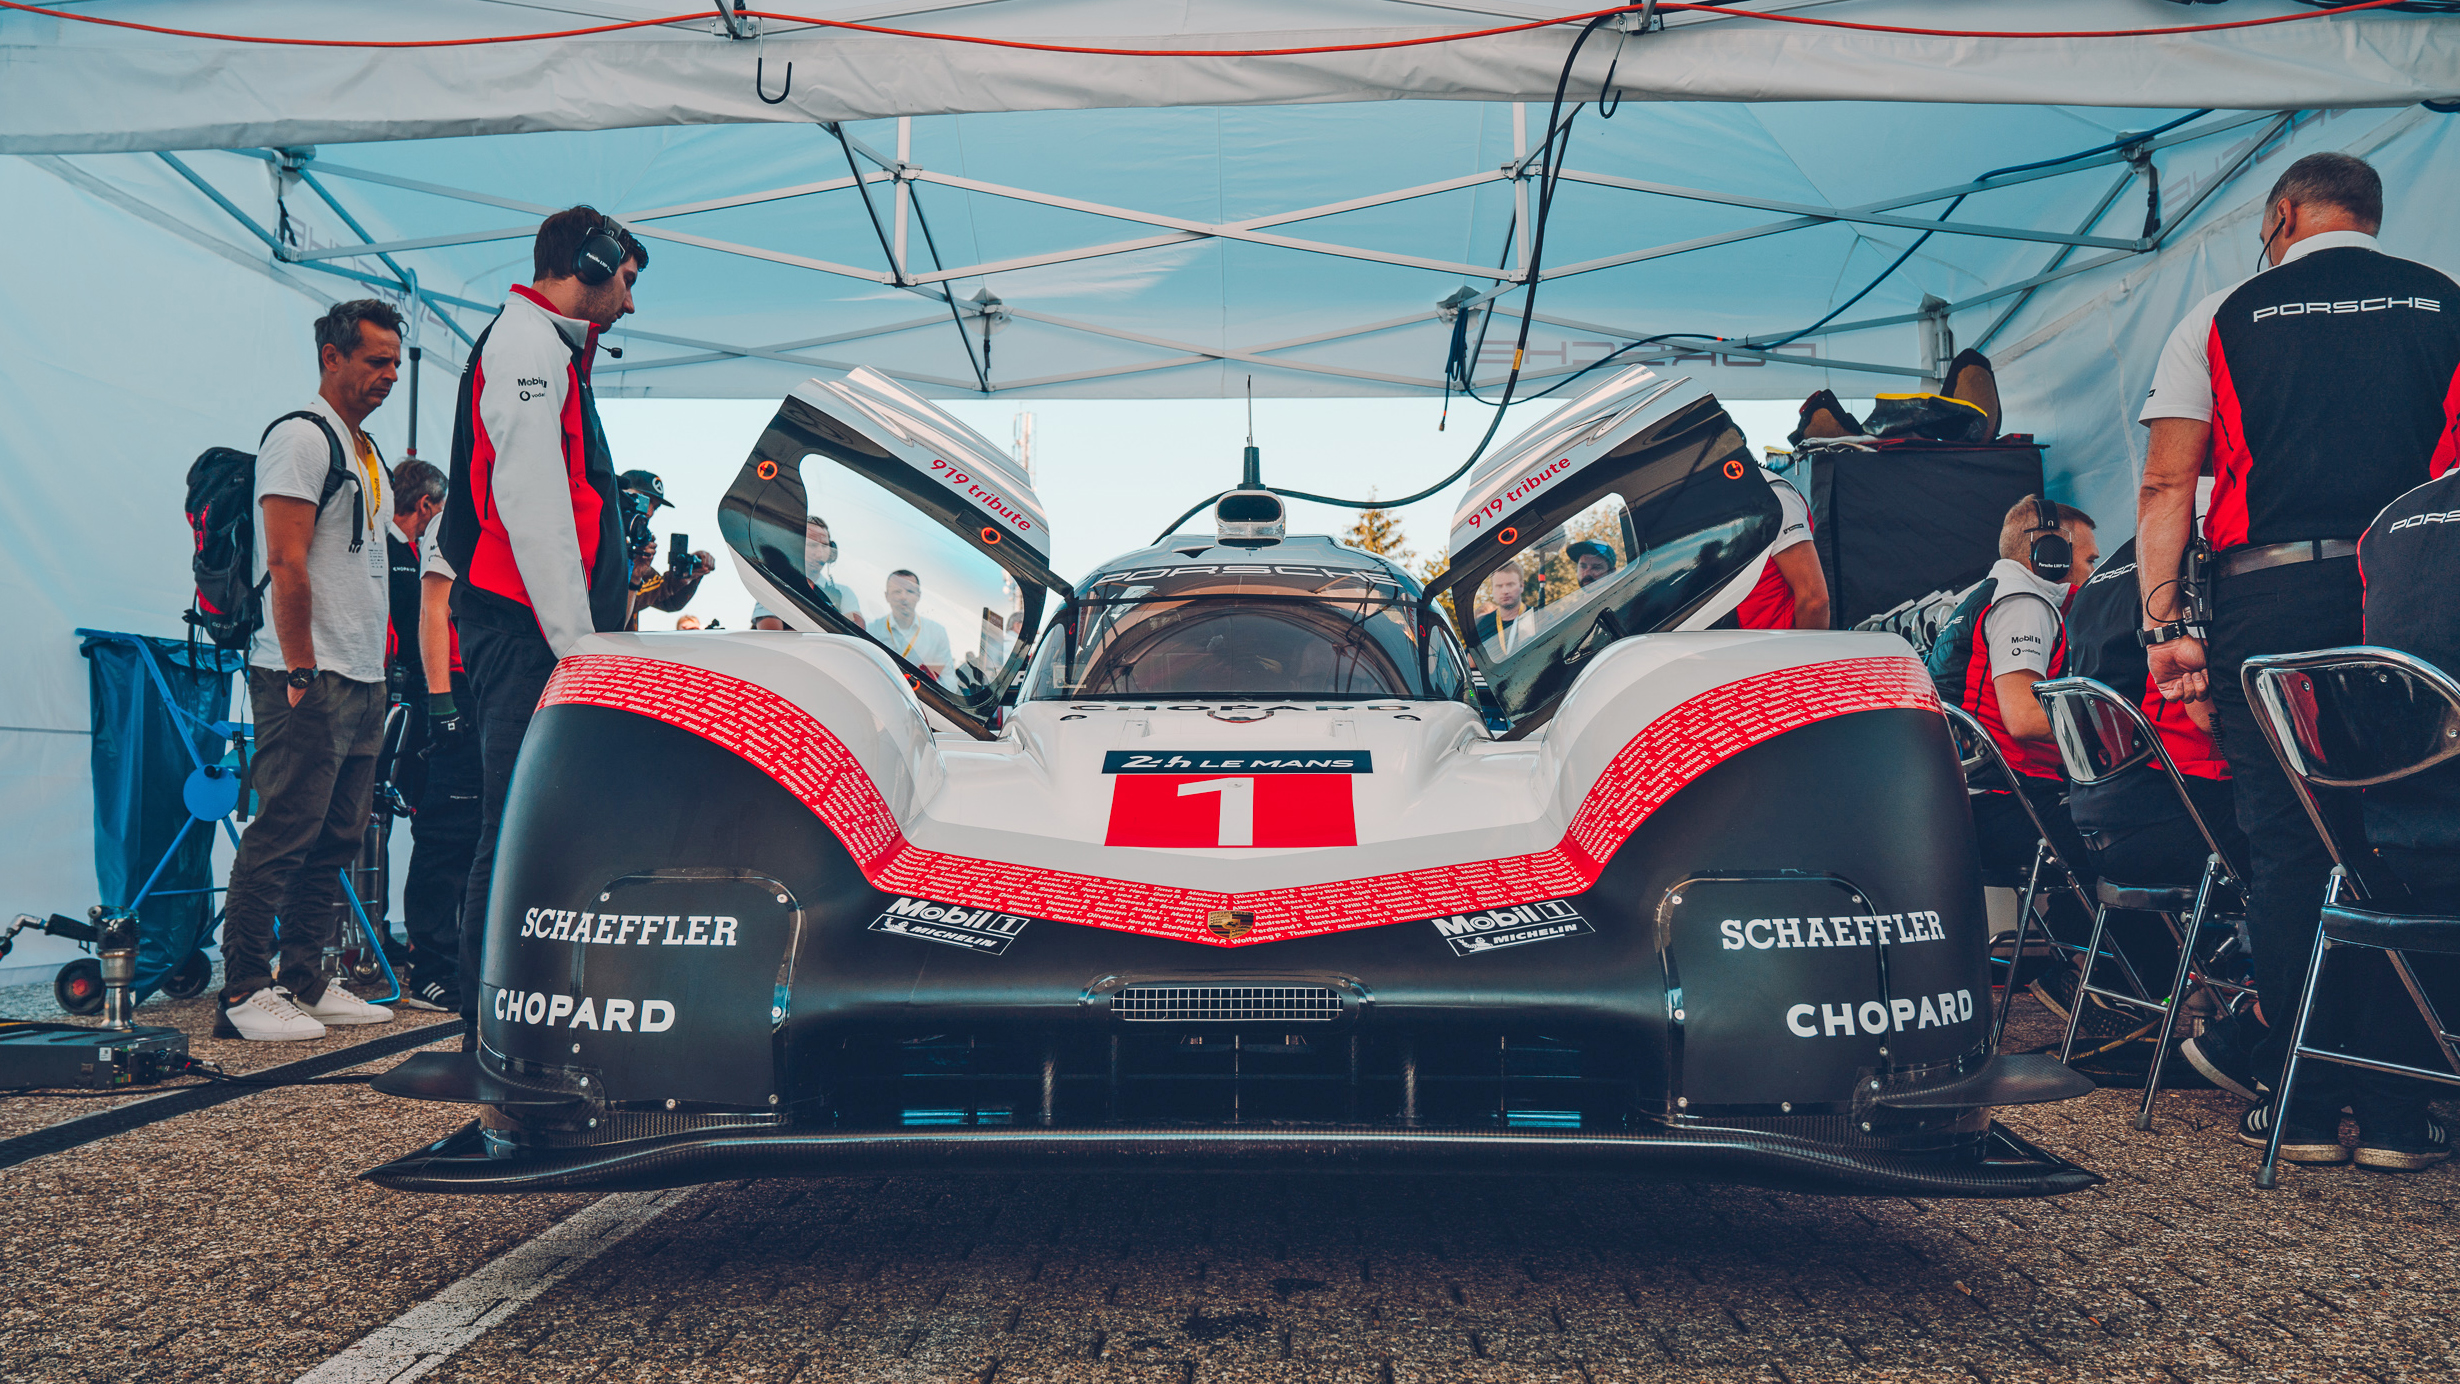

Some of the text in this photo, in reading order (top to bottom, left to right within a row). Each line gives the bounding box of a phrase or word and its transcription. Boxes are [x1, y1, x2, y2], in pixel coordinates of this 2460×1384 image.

[2253, 297, 2441, 322] PORSCHE
[930, 459, 1030, 530] 919 tribute
[1468, 458, 1570, 529] 919 tribute
[1091, 565, 1403, 588] PORSCHE
[2085, 562, 2138, 588] PORSCH
[2011, 635, 2034, 643] Mobil
[1199, 760, 1222, 768] LE
[1250, 759, 1354, 768] MANS
[1177, 777, 1254, 846] 1
[521, 907, 738, 946] SCHAEFFLER
[886, 897, 1017, 932] Mobil 1
[1431, 903, 1565, 936] Mobil 1
[1720, 910, 1945, 950] SCHAEFFLER
[910, 926, 997, 947] MICHELIN
[1493, 924, 1577, 944] MICHELIN
[494, 988, 675, 1032] CHOPARD
[1786, 989, 1973, 1037] CHOPARD
